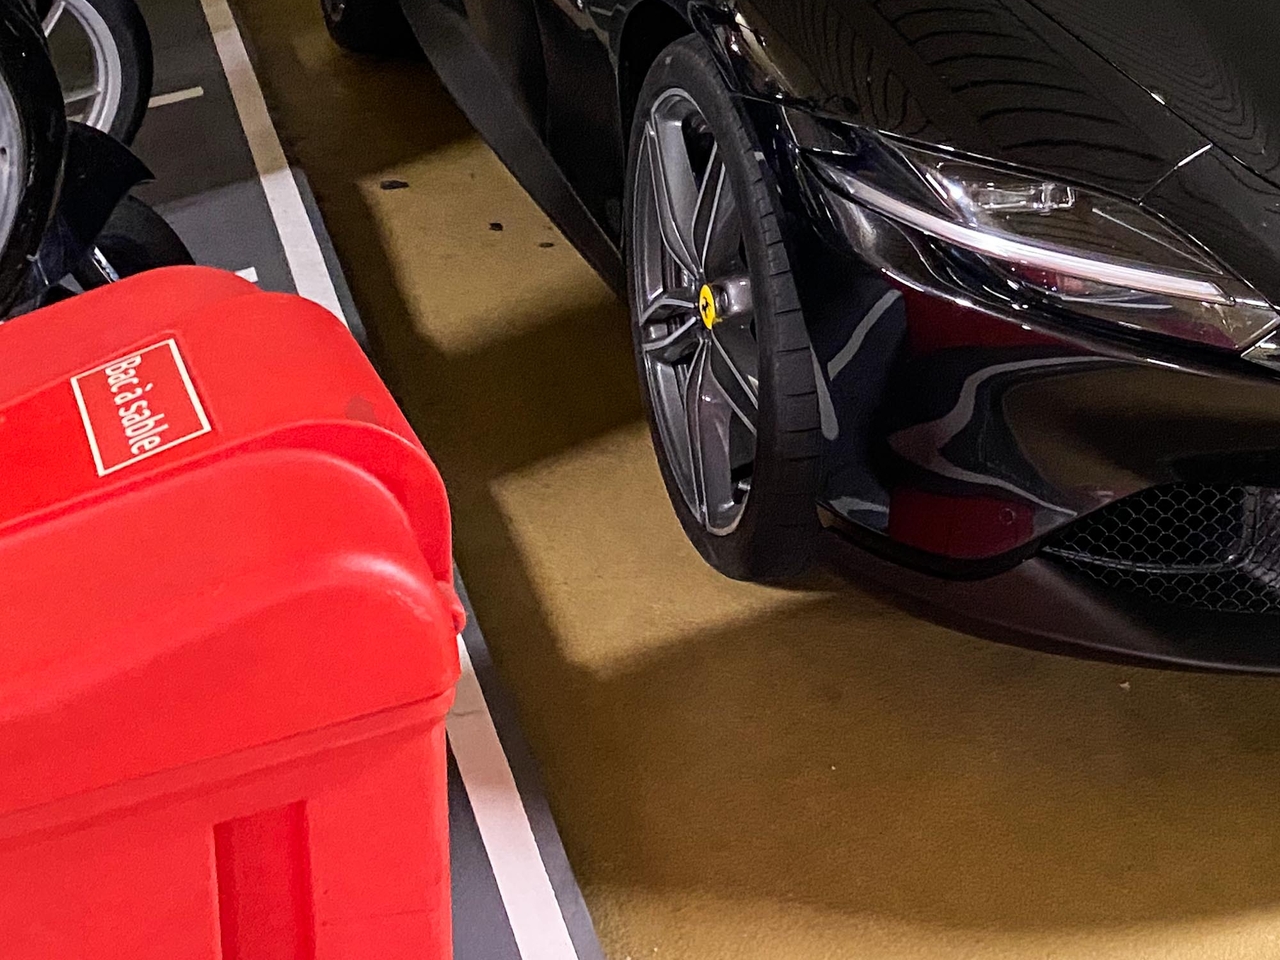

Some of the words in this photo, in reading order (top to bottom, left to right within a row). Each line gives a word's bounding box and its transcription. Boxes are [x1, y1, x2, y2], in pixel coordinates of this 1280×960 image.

[105, 354, 142, 393] Bac
[113, 383, 153, 405] à
[118, 400, 169, 454] sable
